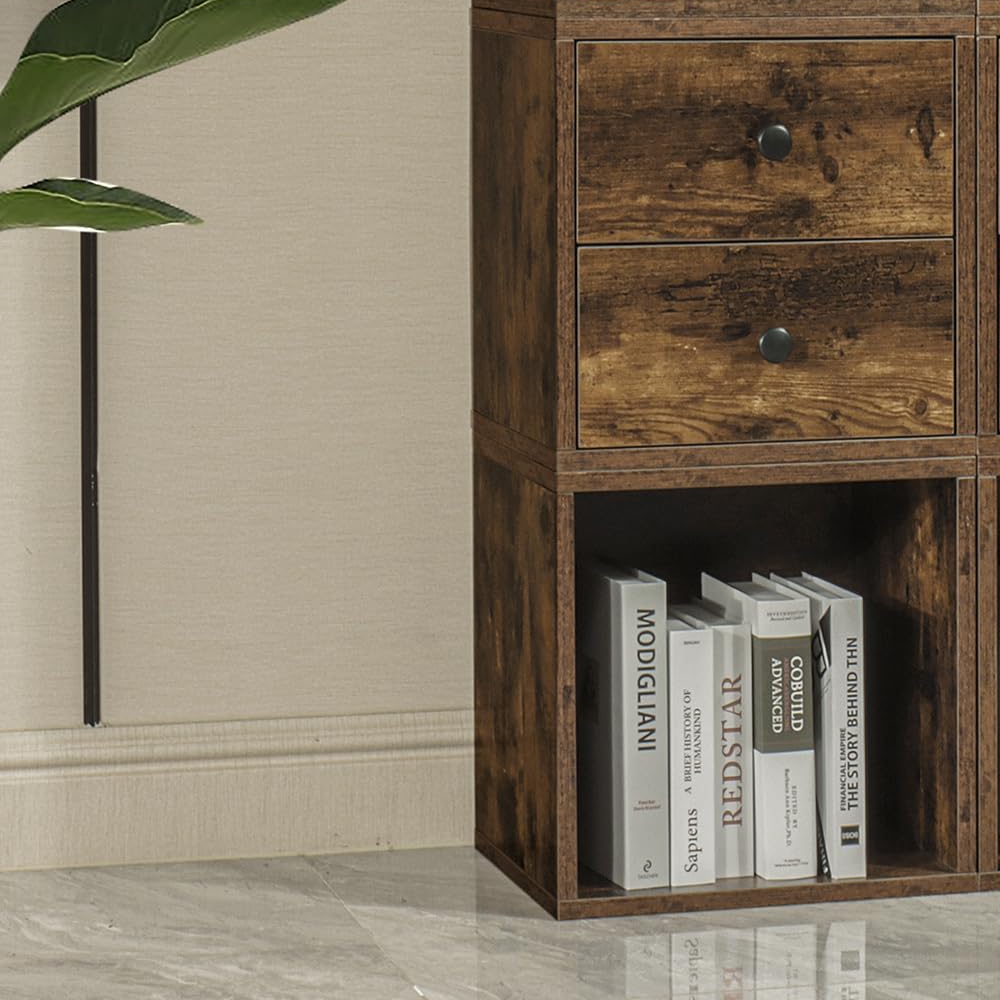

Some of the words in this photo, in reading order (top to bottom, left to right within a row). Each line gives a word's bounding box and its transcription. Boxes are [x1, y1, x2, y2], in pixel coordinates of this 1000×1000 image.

[846, 637, 858, 668] THN
[637, 608, 656, 752] MODIGLIANI
[683, 689, 692, 704] OF
[771, 657, 784, 734] ADVANCED
[790, 656, 804, 732] COBUILD
[846, 671, 858, 728] BEHIND
[683, 705, 692, 751] HISTORY
[693, 707, 702, 774] HUMANKIND
[721, 673, 743, 828] REDSTAR
[839, 728, 847, 761] EMPIRE
[683, 751, 692, 782] BRIEF
[847, 731, 859, 778] STORY
[839, 762, 847, 812] FINANCIAL
[847, 782, 859, 811] THE
[684, 807, 702, 873] Sapiens
